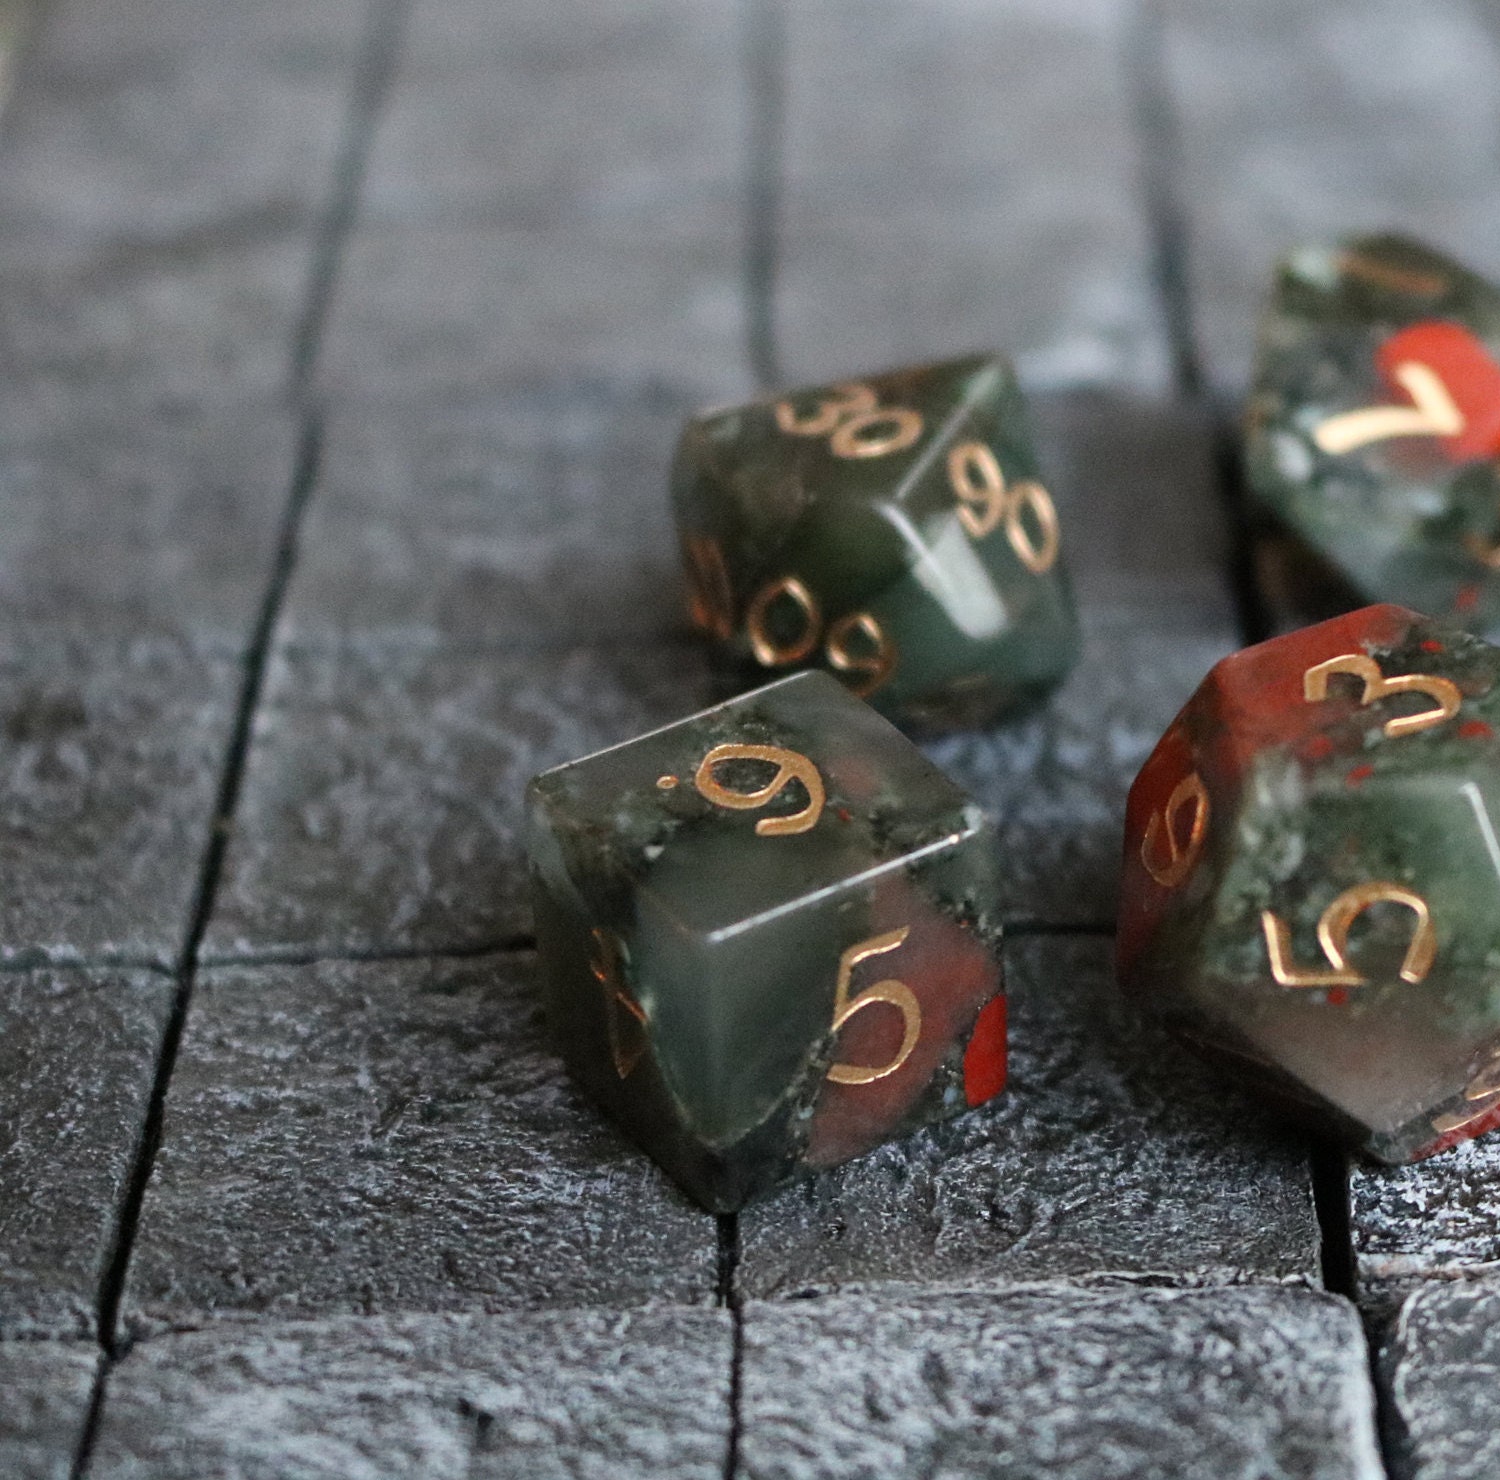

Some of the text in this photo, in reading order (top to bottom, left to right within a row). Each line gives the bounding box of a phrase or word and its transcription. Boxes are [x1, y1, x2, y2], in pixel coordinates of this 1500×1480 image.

[774, 383, 924, 459] 30
[1313, 361, 1467, 456] 7
[949, 441, 1059, 574] 90
[1304, 653, 1463, 739] 3
[1261, 881, 1438, 987] 5
[827, 925, 922, 1085] 5
